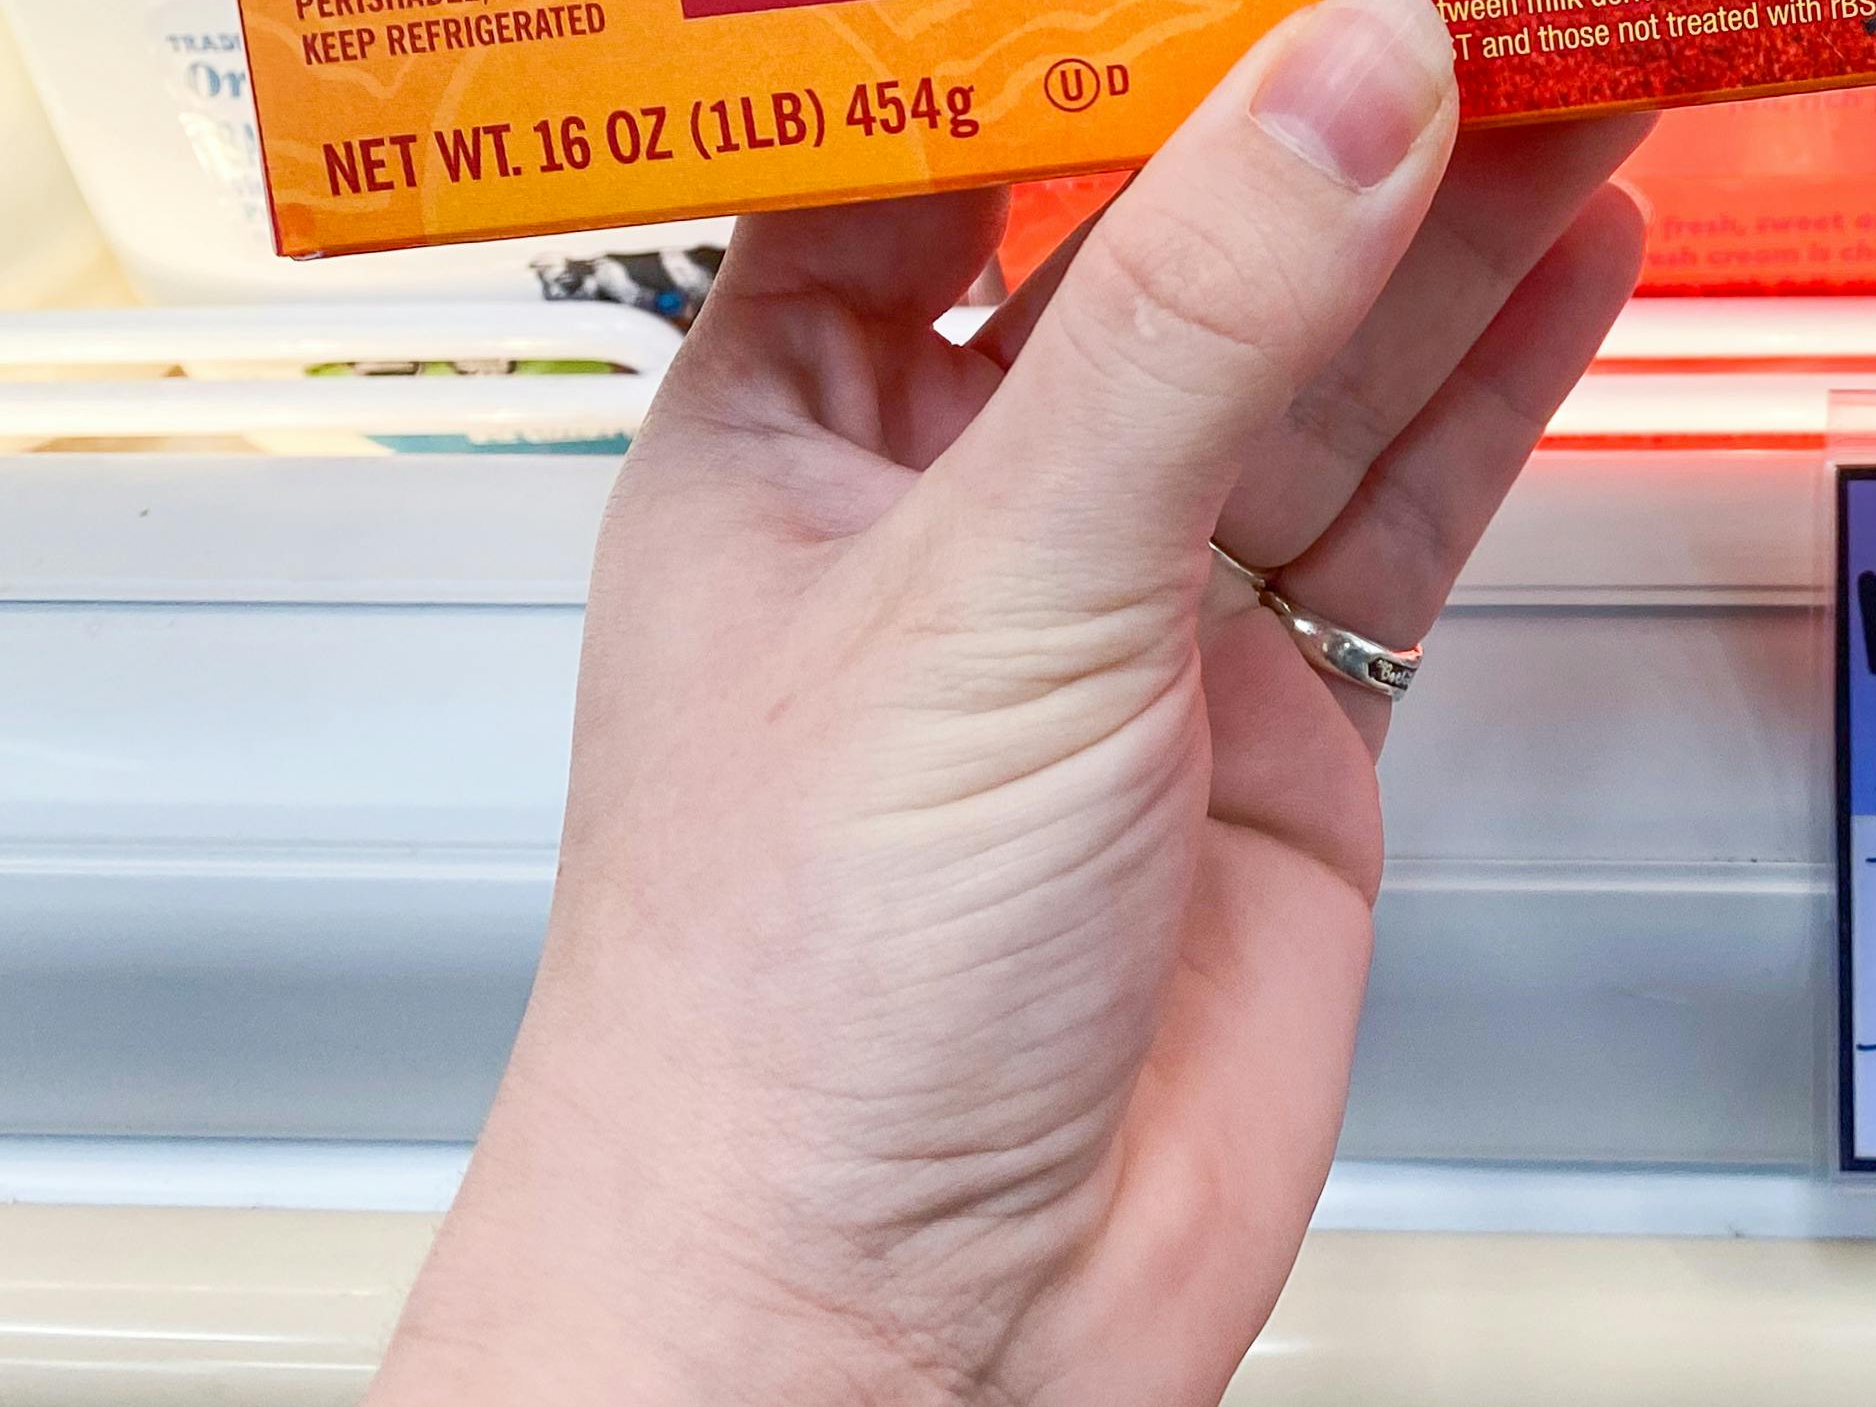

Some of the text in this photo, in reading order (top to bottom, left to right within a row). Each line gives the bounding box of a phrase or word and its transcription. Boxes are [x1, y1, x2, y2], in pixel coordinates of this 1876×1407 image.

[303, 3, 606, 66] KEEP REFRIGERATED
[1481, 28, 1531, 59] and
[1538, 20, 1611, 53] those
[1616, 16, 1662, 44] not
[1667, 2, 1759, 37] treated
[323, 134, 418, 196] NET
[433, 124, 522, 184] WT.
[533, 115, 591, 173] 16
[606, 106, 673, 165] OZ
[689, 88, 826, 160] (1LB)
[845, 76, 980, 139] 454g
